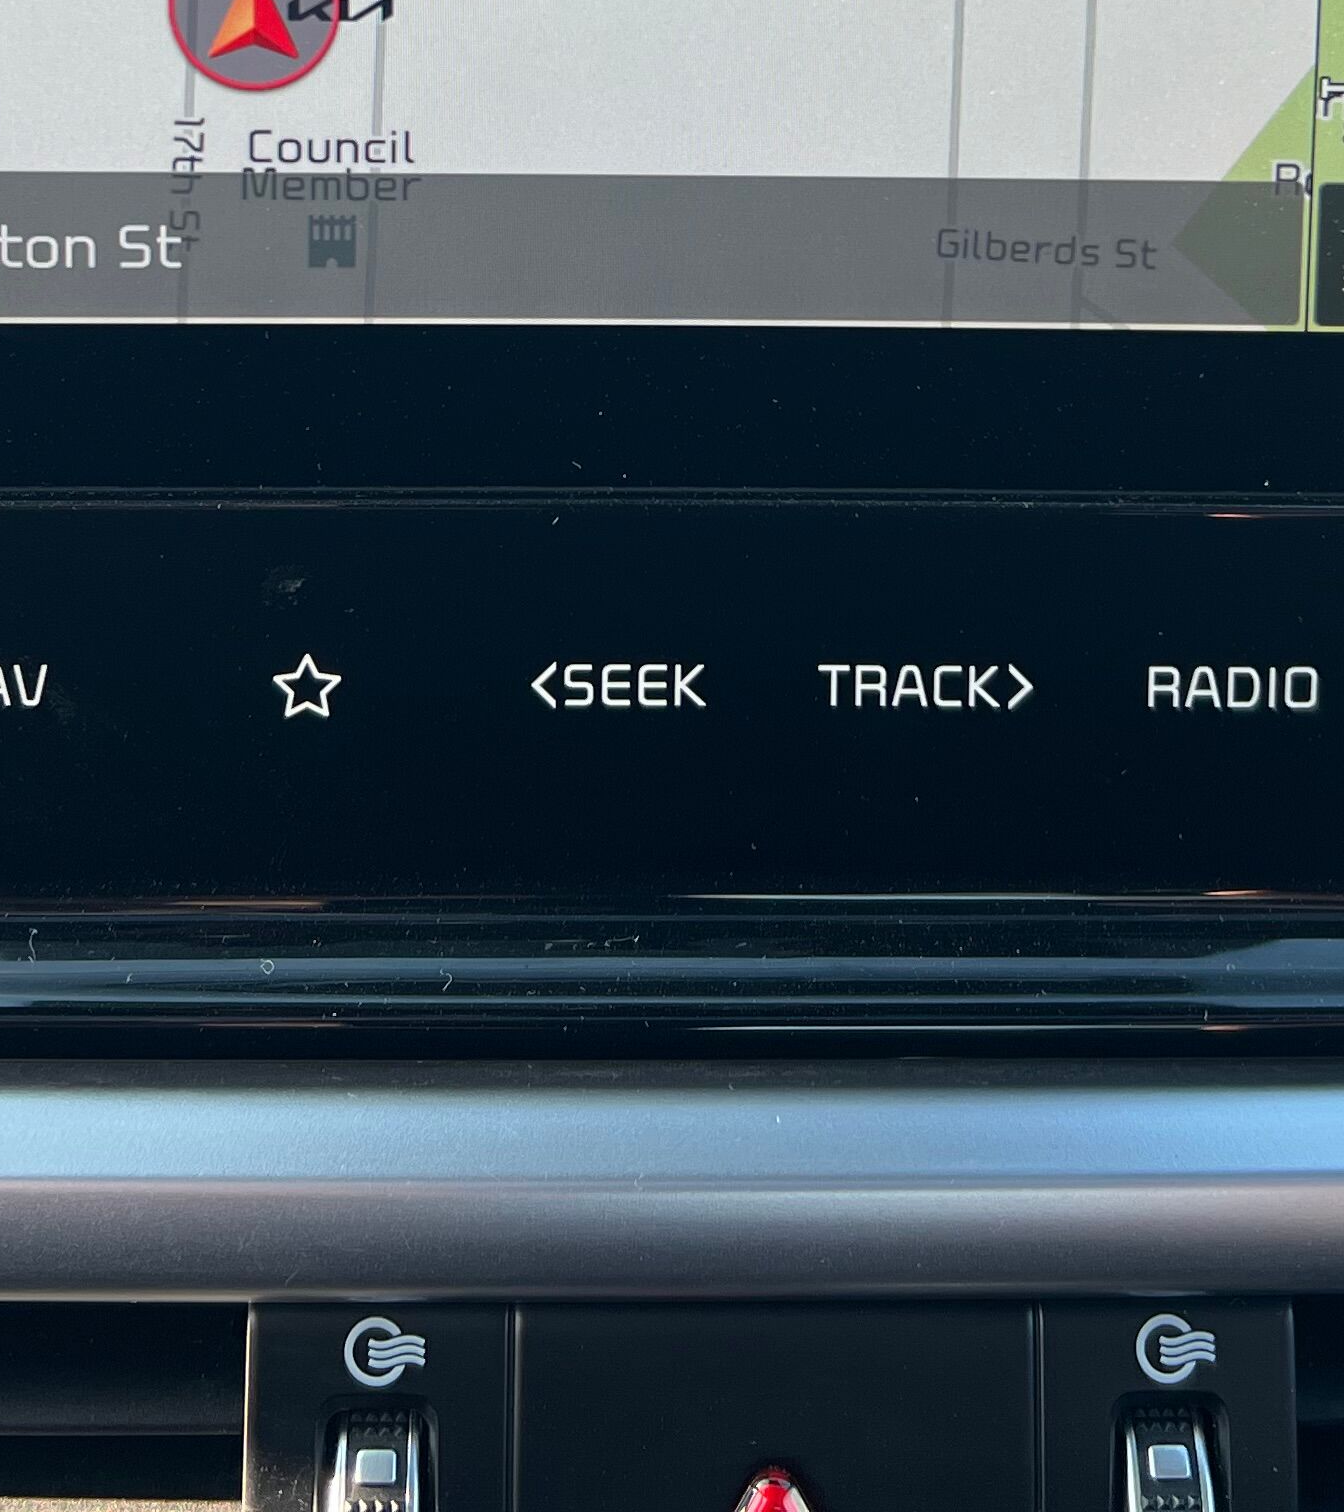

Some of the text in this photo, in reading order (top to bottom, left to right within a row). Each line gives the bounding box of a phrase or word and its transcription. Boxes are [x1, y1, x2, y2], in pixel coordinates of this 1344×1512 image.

[171, 117, 205, 195] 17th
[249, 129, 414, 165] Council
[242, 167, 422, 202] Member
[118, 224, 183, 270] St
[937, 229, 1157, 271] Gilberds St
[1147, 665, 1318, 710] RADIO
